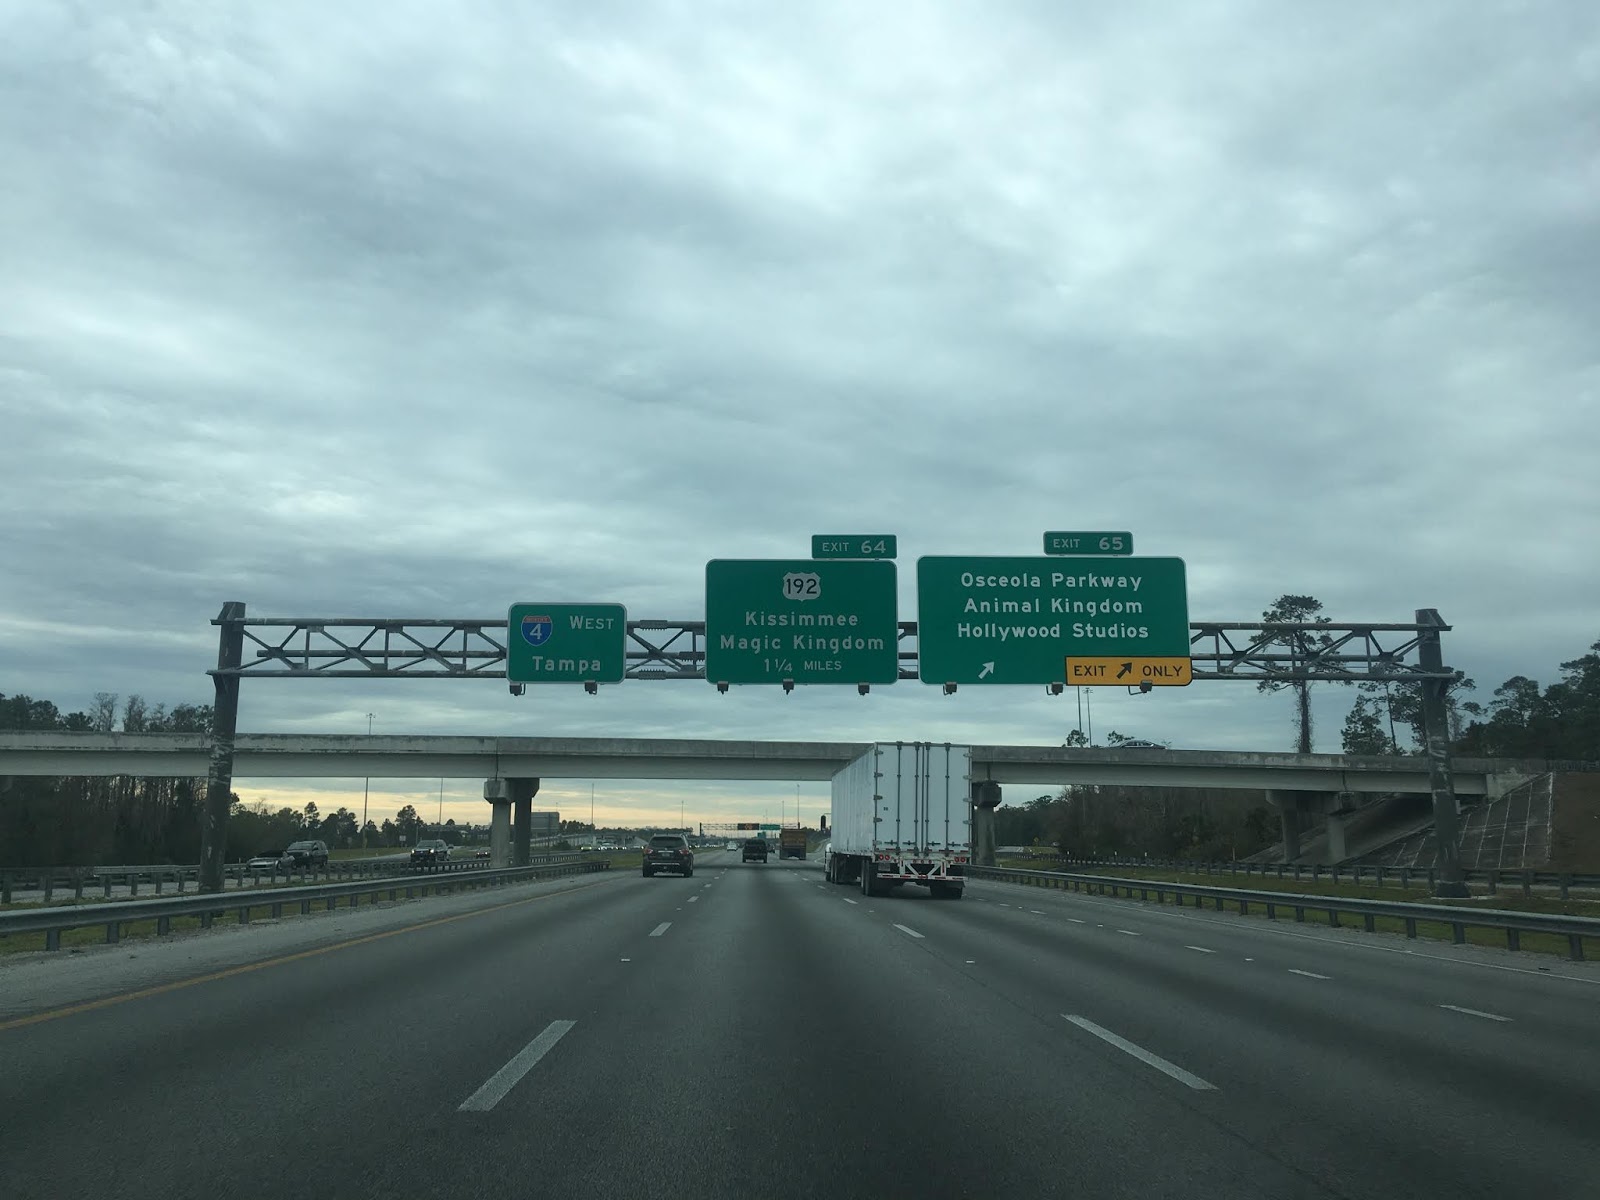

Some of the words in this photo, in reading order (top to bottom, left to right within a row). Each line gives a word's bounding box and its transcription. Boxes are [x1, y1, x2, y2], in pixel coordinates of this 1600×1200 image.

[822, 542, 850, 552] EXIT
[860, 540, 887, 554] 64
[1053, 538, 1080, 548] EXIT
[1098, 537, 1124, 551] 65
[785, 578, 818, 595] 192
[960, 572, 1041, 588] Osceola
[1051, 572, 1143, 591] Parkway
[964, 598, 1040, 613] Animal
[1051, 598, 1143, 617] Kingdom
[569, 616, 614, 630] WEST
[745, 611, 859, 626] Kissimmee
[529, 623, 543, 640] 4
[957, 623, 1061, 641] Hollywood
[1072, 623, 1149, 638] Studios
[720, 635, 781, 654] Magic
[793, 635, 884, 654] Kingdom
[532, 656, 601, 675] Tampa
[804, 660, 842, 670] MILES
[1074, 665, 1107, 677] EXIT
[1142, 665, 1183, 677] ONLY
